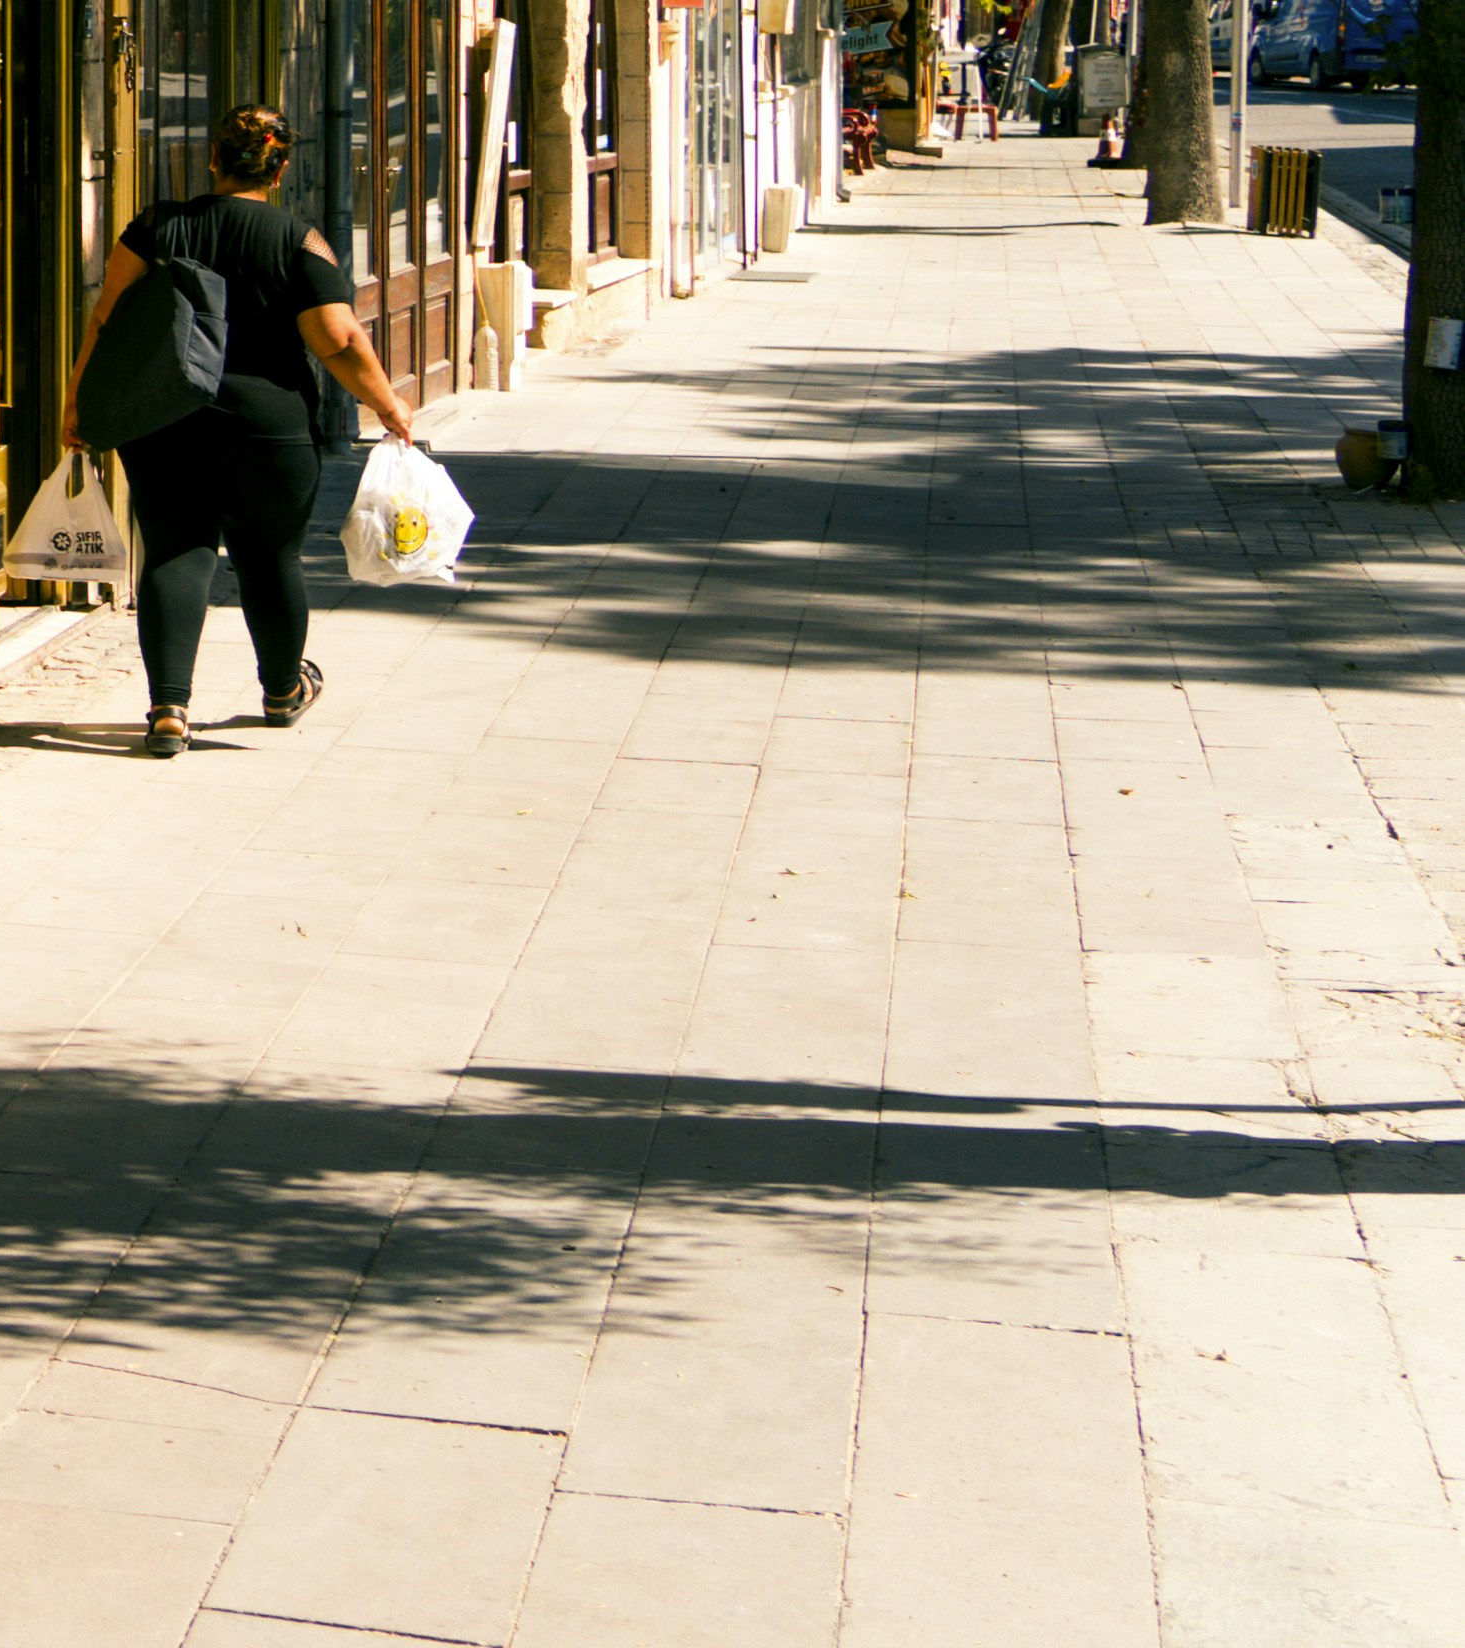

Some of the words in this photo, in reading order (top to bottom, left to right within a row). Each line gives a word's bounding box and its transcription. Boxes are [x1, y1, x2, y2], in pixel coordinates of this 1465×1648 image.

[841, 33, 879, 50] elight
[75, 531, 103, 542] SIFIR
[75, 542, 105, 554] ATIK
